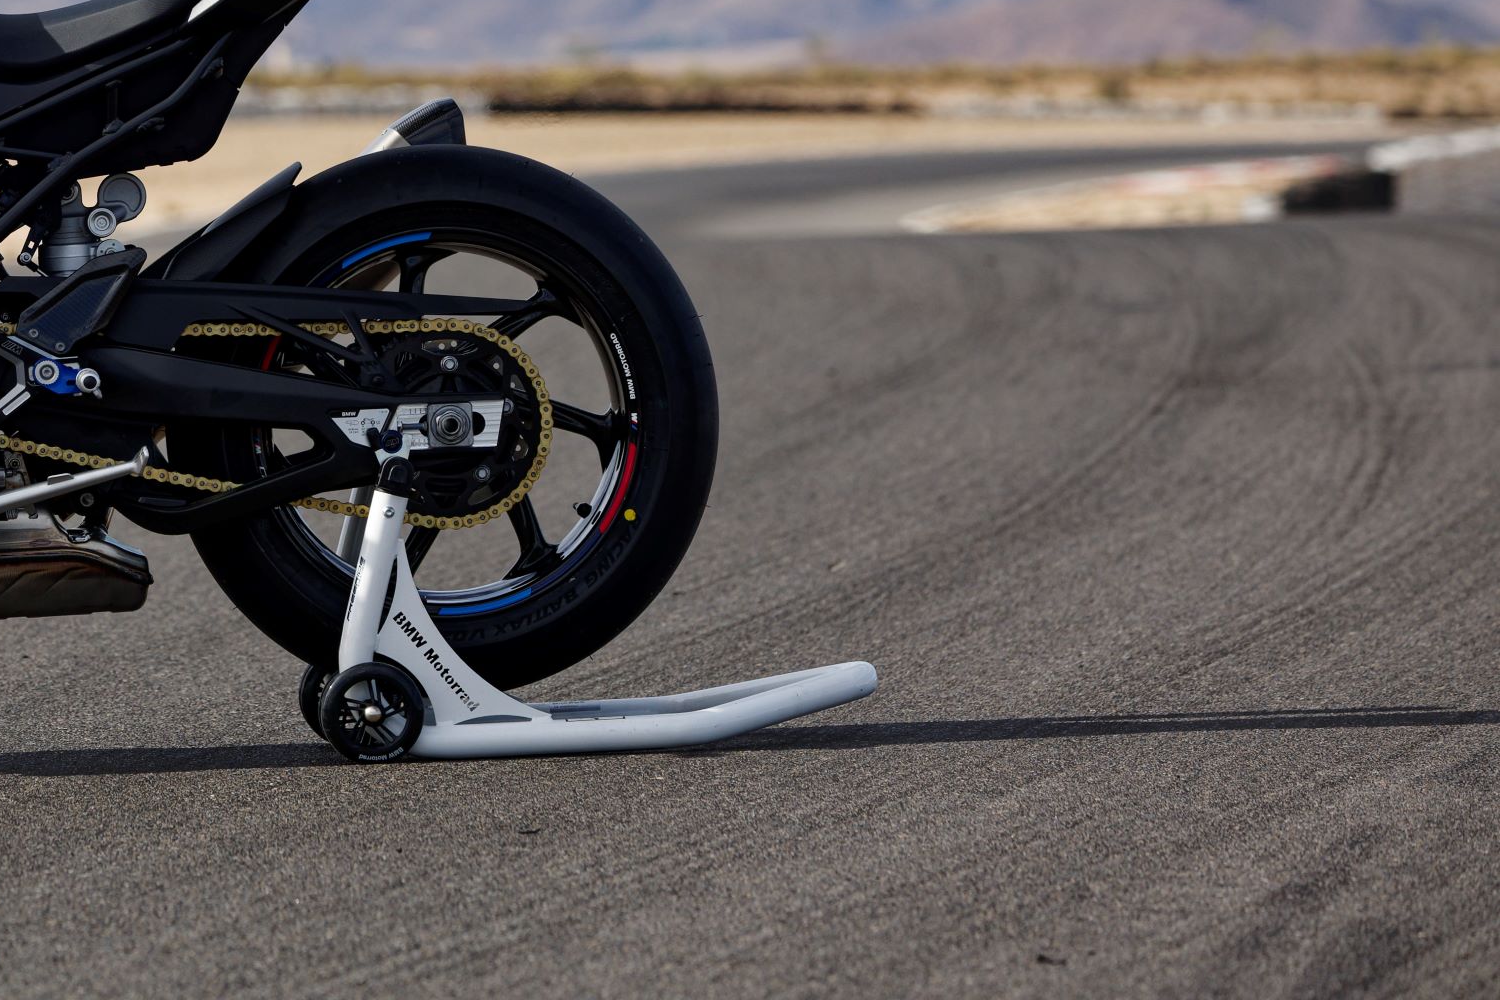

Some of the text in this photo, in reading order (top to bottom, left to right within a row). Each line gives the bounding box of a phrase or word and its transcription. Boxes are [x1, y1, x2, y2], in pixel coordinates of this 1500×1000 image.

[610, 332, 636, 400] BMW MOTORRAD
[393, 611, 480, 712] BMW Motorrad
